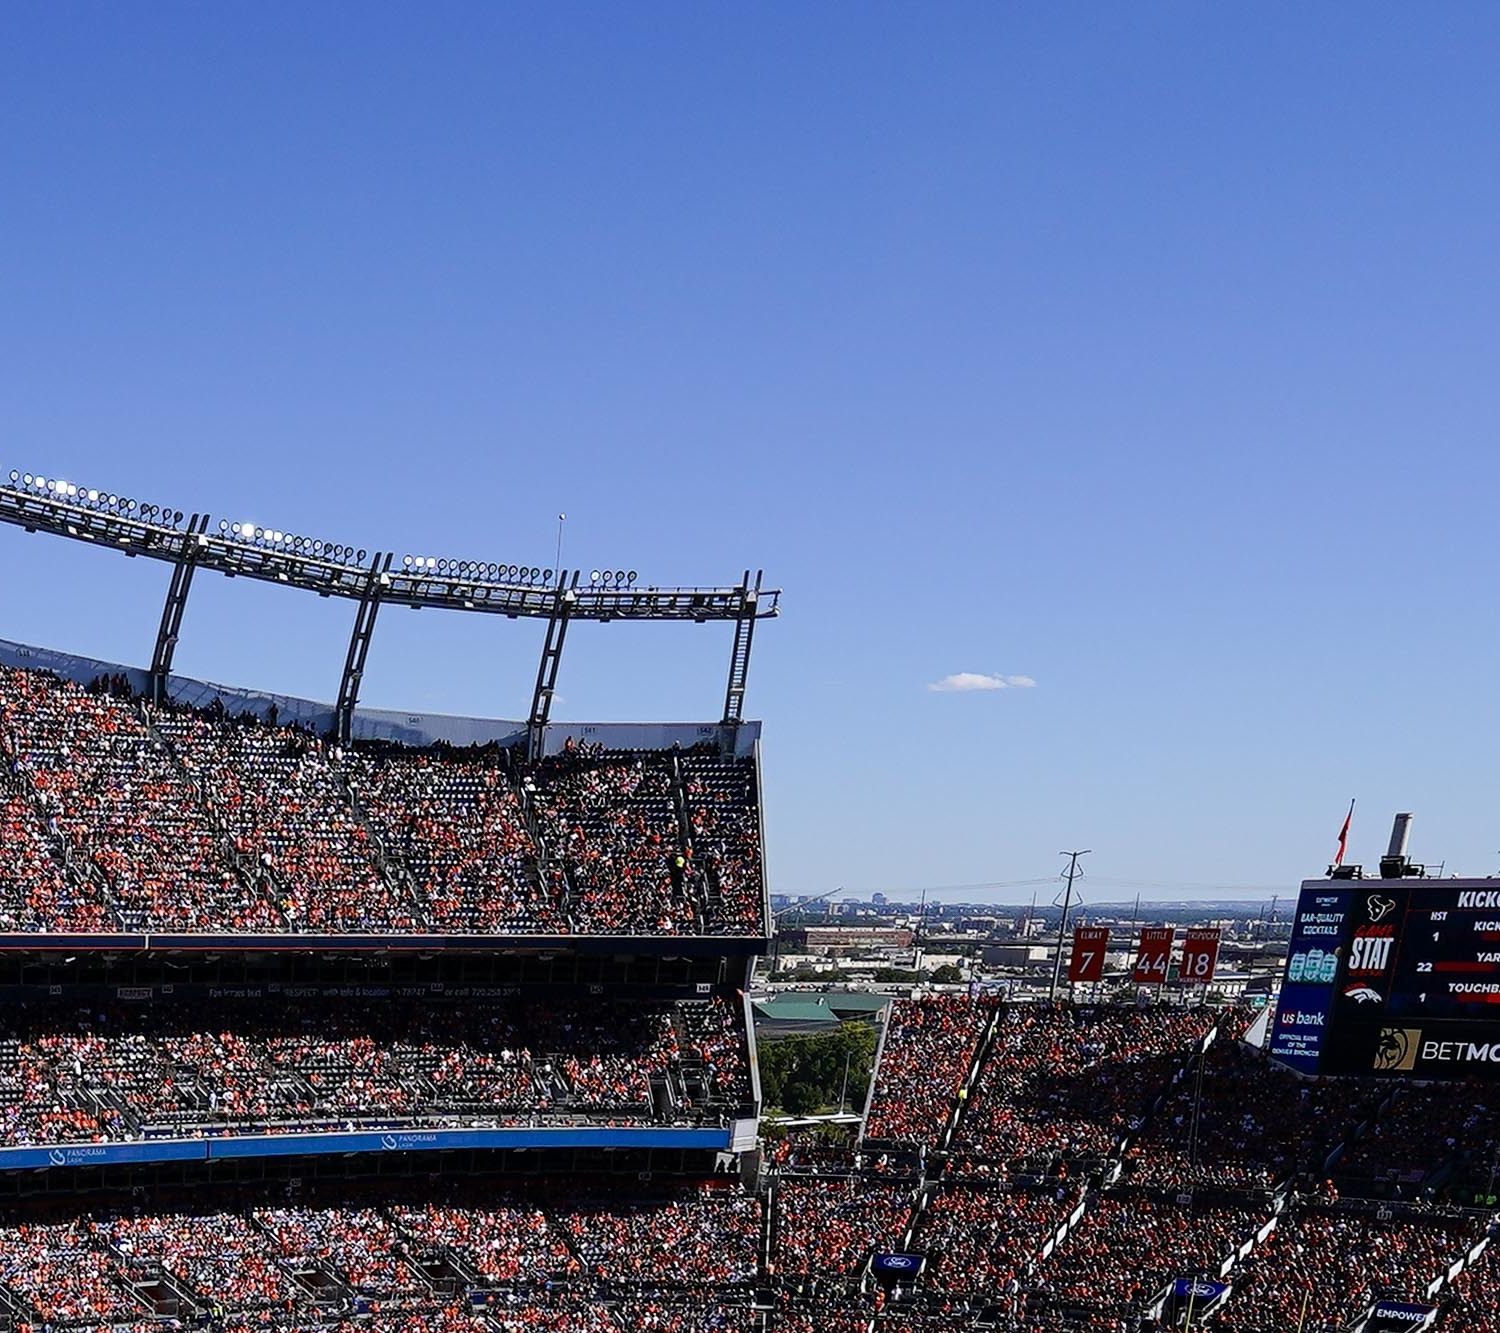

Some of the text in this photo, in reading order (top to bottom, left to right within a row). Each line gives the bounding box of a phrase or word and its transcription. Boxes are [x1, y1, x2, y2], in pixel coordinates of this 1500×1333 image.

[1301, 913, 1344, 923] BAR-QUALITY
[1430, 911, 1448, 921] HST
[1348, 938, 1394, 970] STAT
[1079, 952, 1095, 974] 7
[1137, 952, 1166, 974] 44
[1185, 953, 1210, 976] 18
[1416, 963, 1433, 972] 22
[1281, 1011, 1324, 1025] us bank
[399, 1135, 437, 1143] PANORAMA
[62, 1148, 106, 1160] PANORAMA
